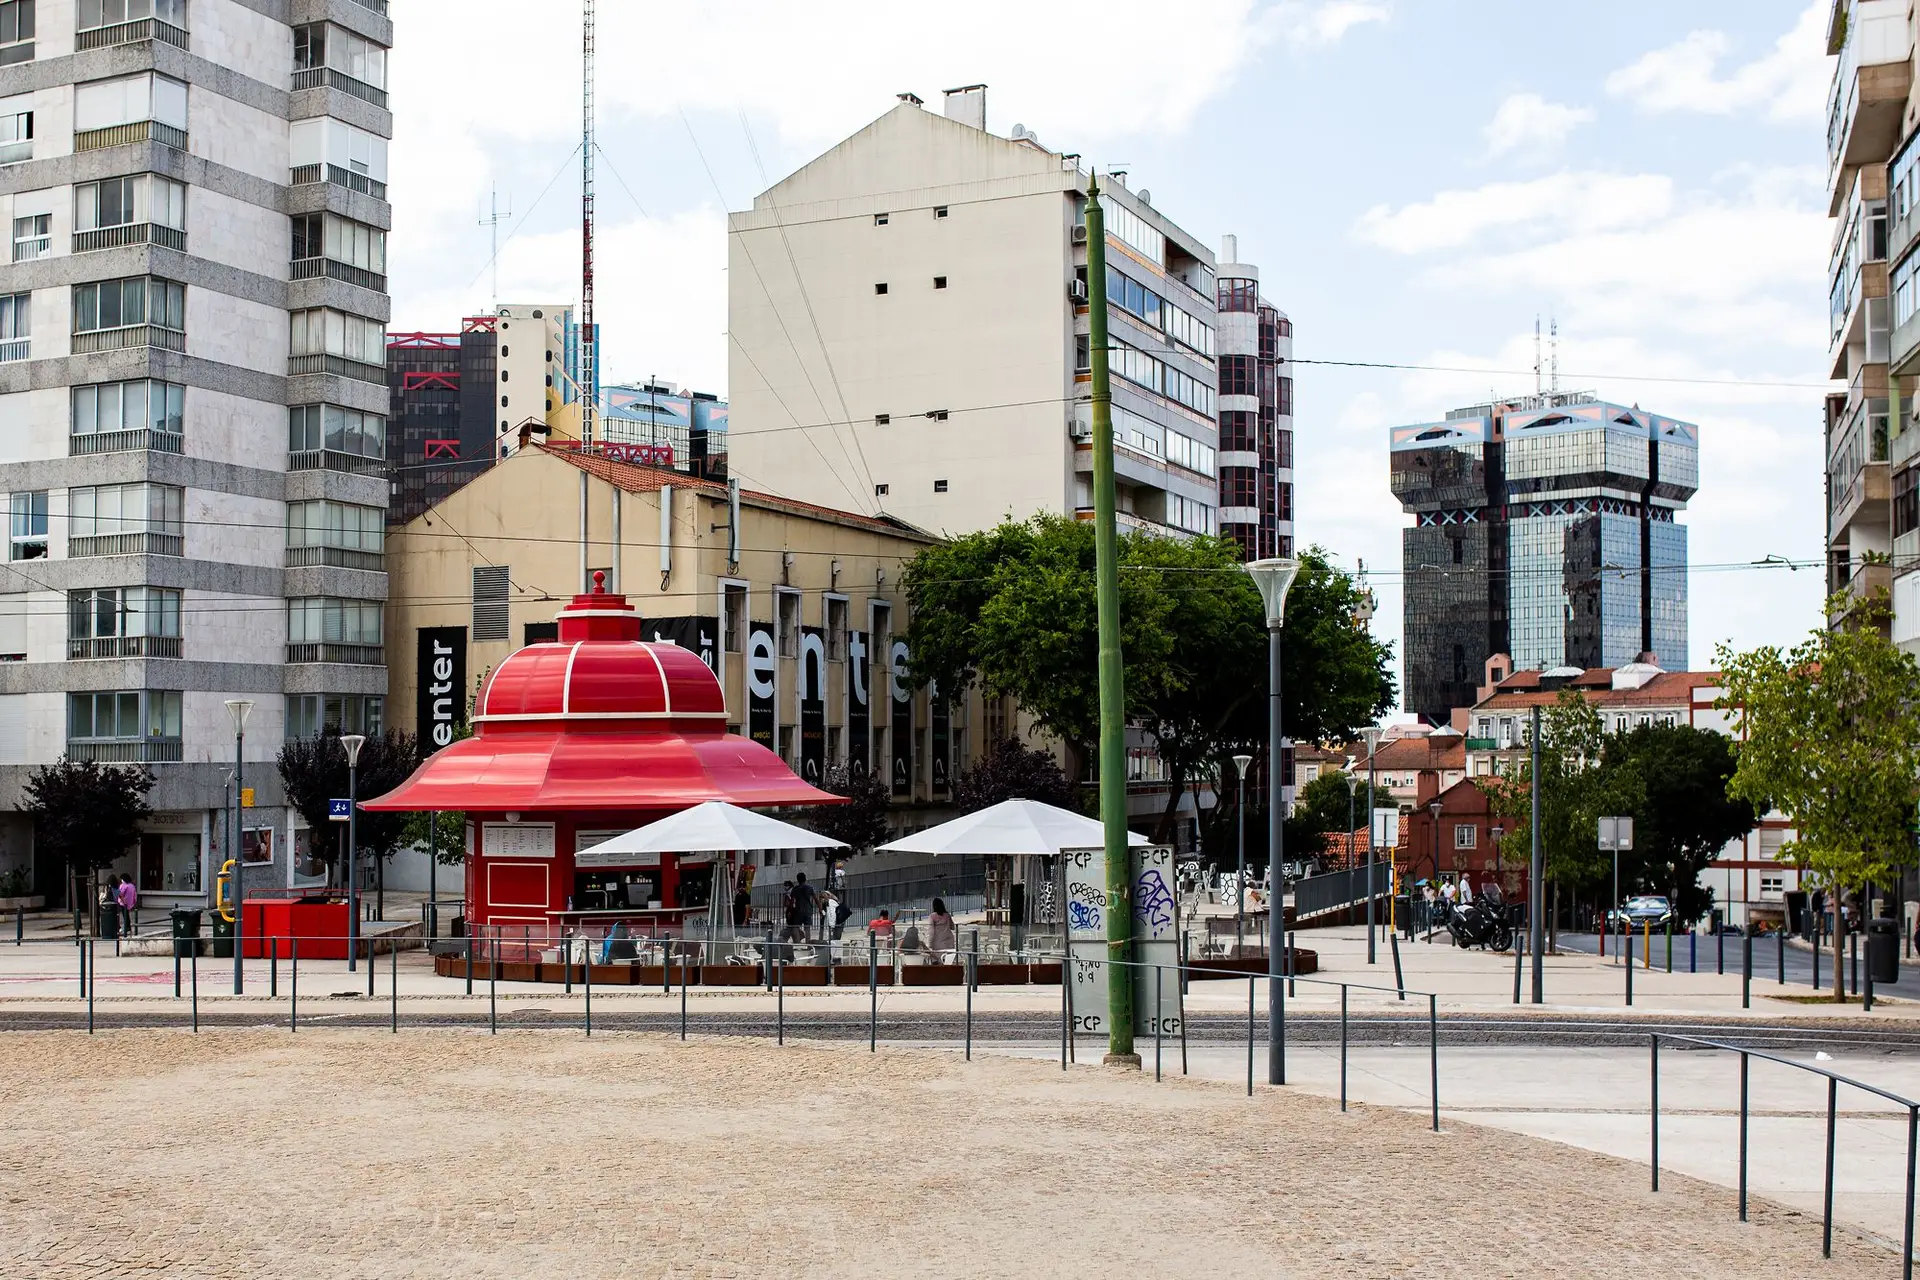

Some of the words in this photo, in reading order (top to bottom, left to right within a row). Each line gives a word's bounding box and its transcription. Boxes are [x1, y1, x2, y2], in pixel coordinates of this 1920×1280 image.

[433, 639, 453, 746] enter
[1064, 852, 1092, 869] PCP
[1140, 849, 1170, 865] PCP
[1073, 1015, 1101, 1031] PCP
